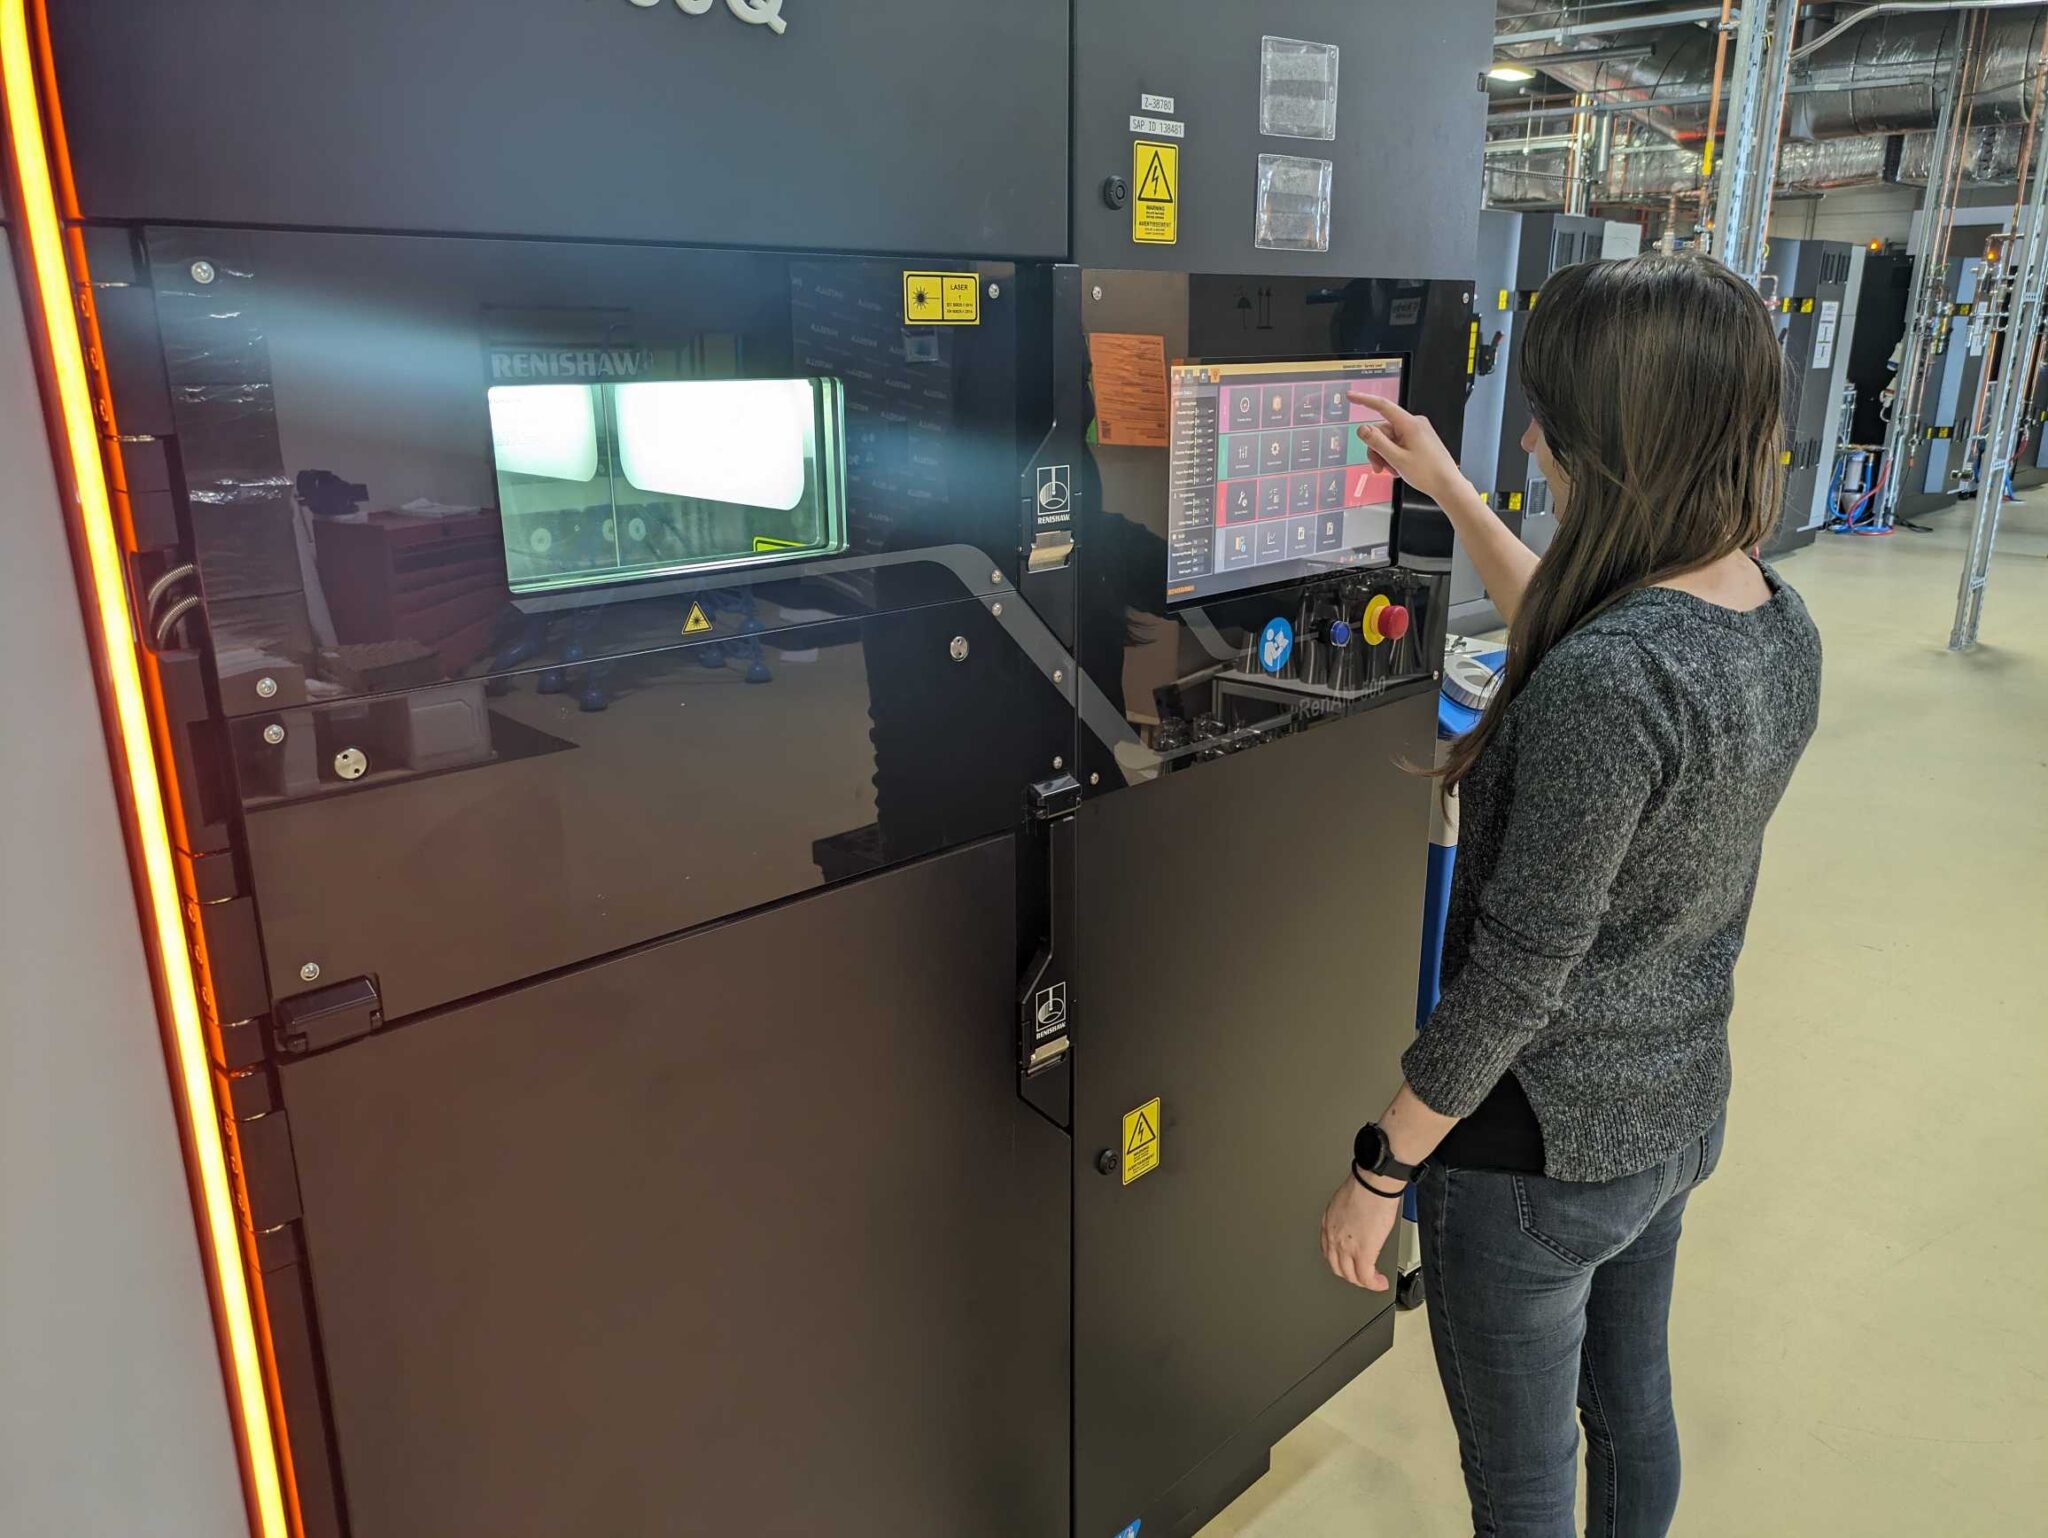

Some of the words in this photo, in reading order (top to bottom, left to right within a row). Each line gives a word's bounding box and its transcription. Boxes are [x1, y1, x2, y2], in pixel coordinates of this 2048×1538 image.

[1132, 118, 1145, 131] SAP
[1148, 121, 1157, 132] ID
[950, 283, 968, 291] LASER
[490, 351, 641, 378] RENISHAW
[1037, 513, 1071, 525] RENISHAW
[1036, 1021, 1067, 1040] RENISHAW
